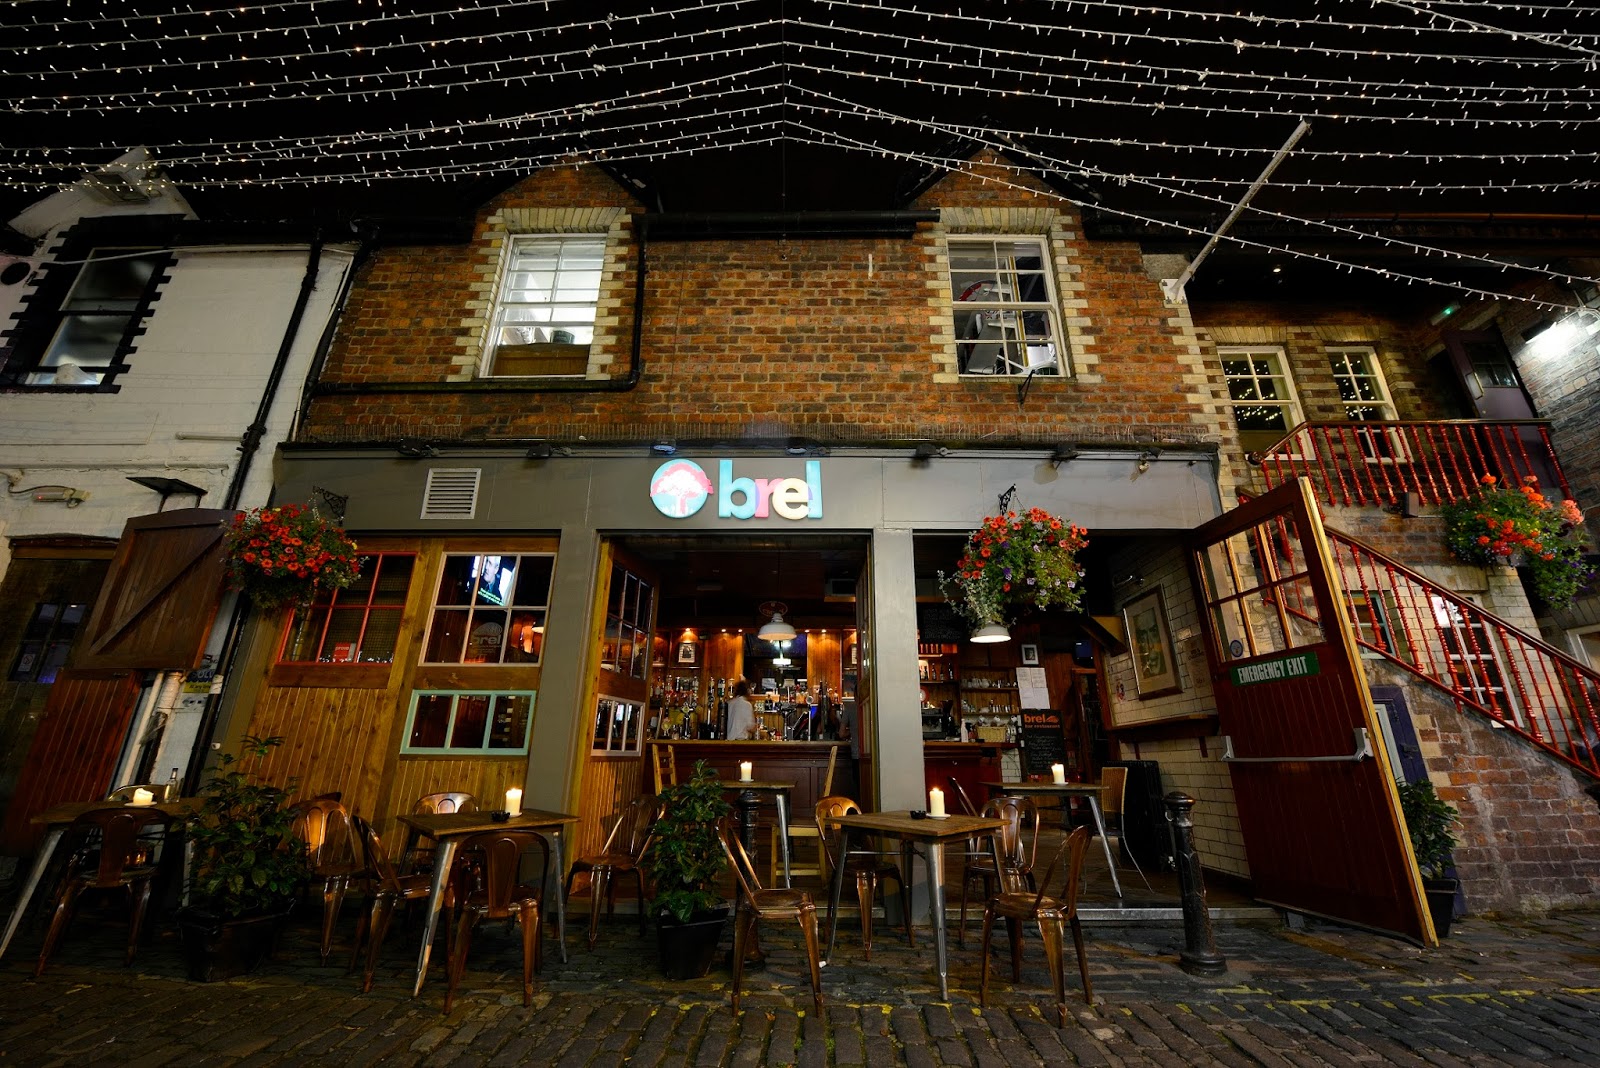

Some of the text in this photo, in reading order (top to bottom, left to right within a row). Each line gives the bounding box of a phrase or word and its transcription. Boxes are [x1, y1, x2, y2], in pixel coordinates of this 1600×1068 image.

[718, 459, 823, 520] brel
[471, 634, 502, 645] brel
[1237, 656, 1308, 684] EMERGENCY EXIT
[1024, 713, 1046, 724] brel
